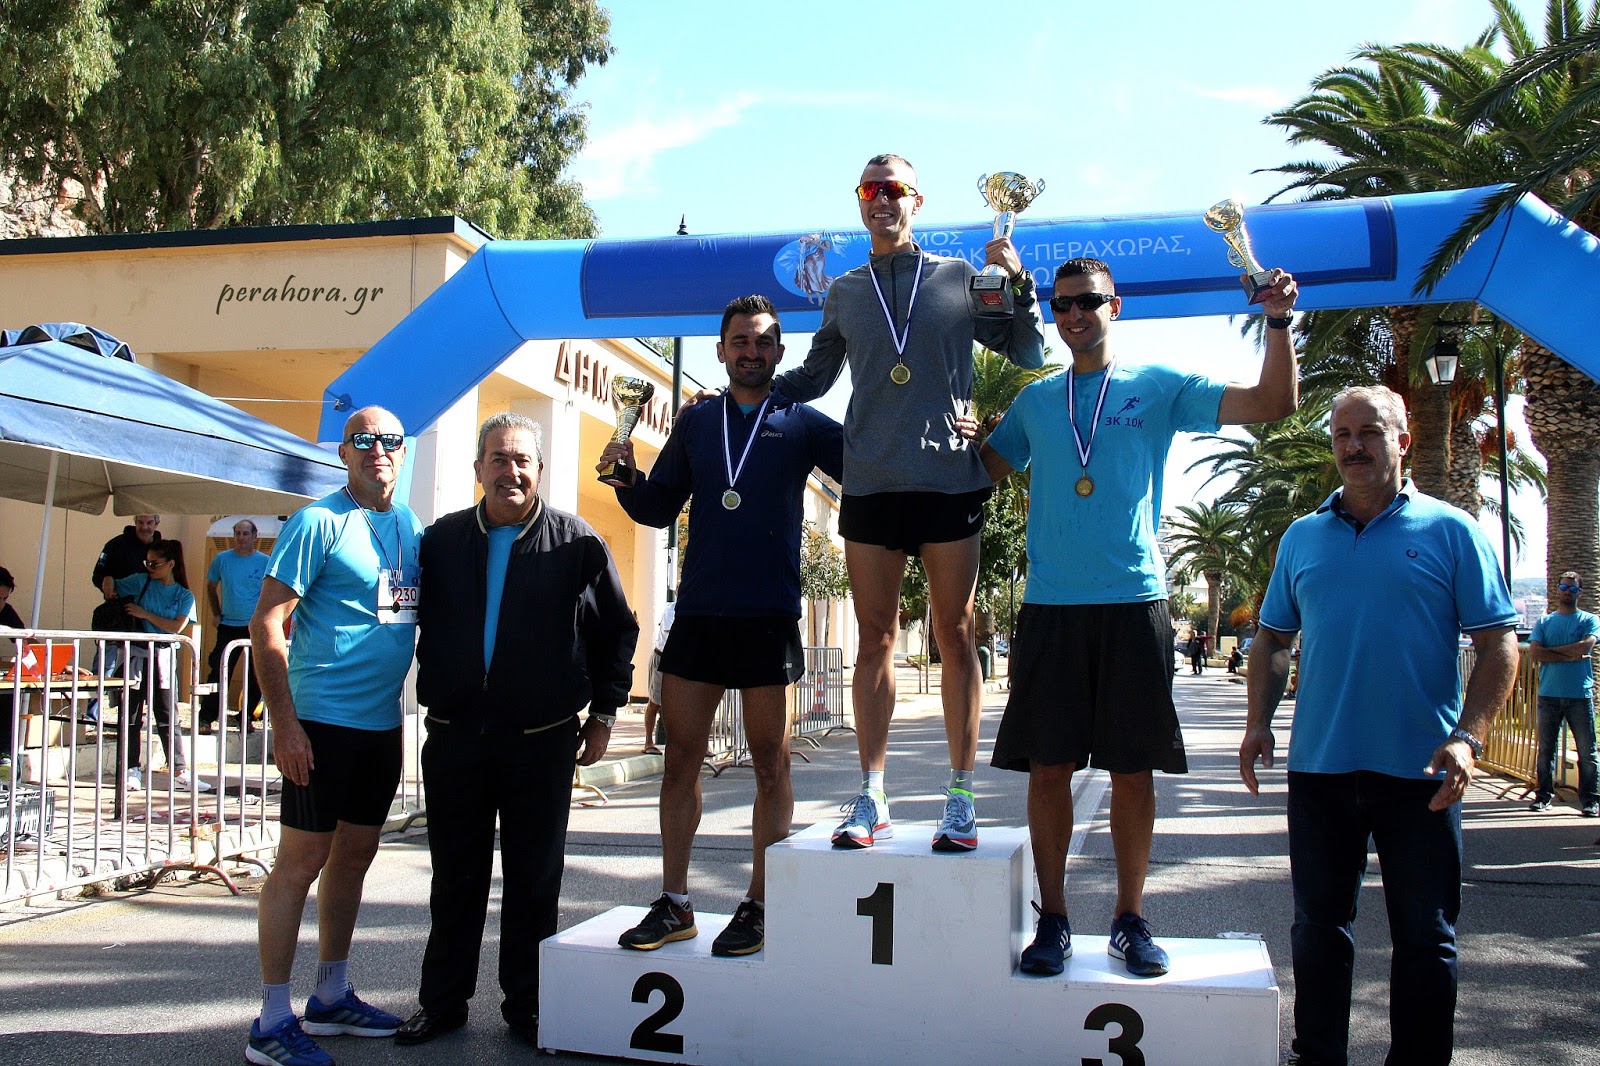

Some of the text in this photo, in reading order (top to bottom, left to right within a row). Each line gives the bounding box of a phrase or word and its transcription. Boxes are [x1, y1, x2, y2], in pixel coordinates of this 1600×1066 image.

[912, 231, 963, 246] ΜΟΣ
[554, 339, 672, 437] ΔΗΜΙΚΑ
[1105, 416, 1144, 429] 3K 10K
[391, 588, 417, 602] 1230
[857, 882, 894, 965] 1
[630, 972, 684, 1054] 2
[1081, 1003, 1146, 1066] 3
